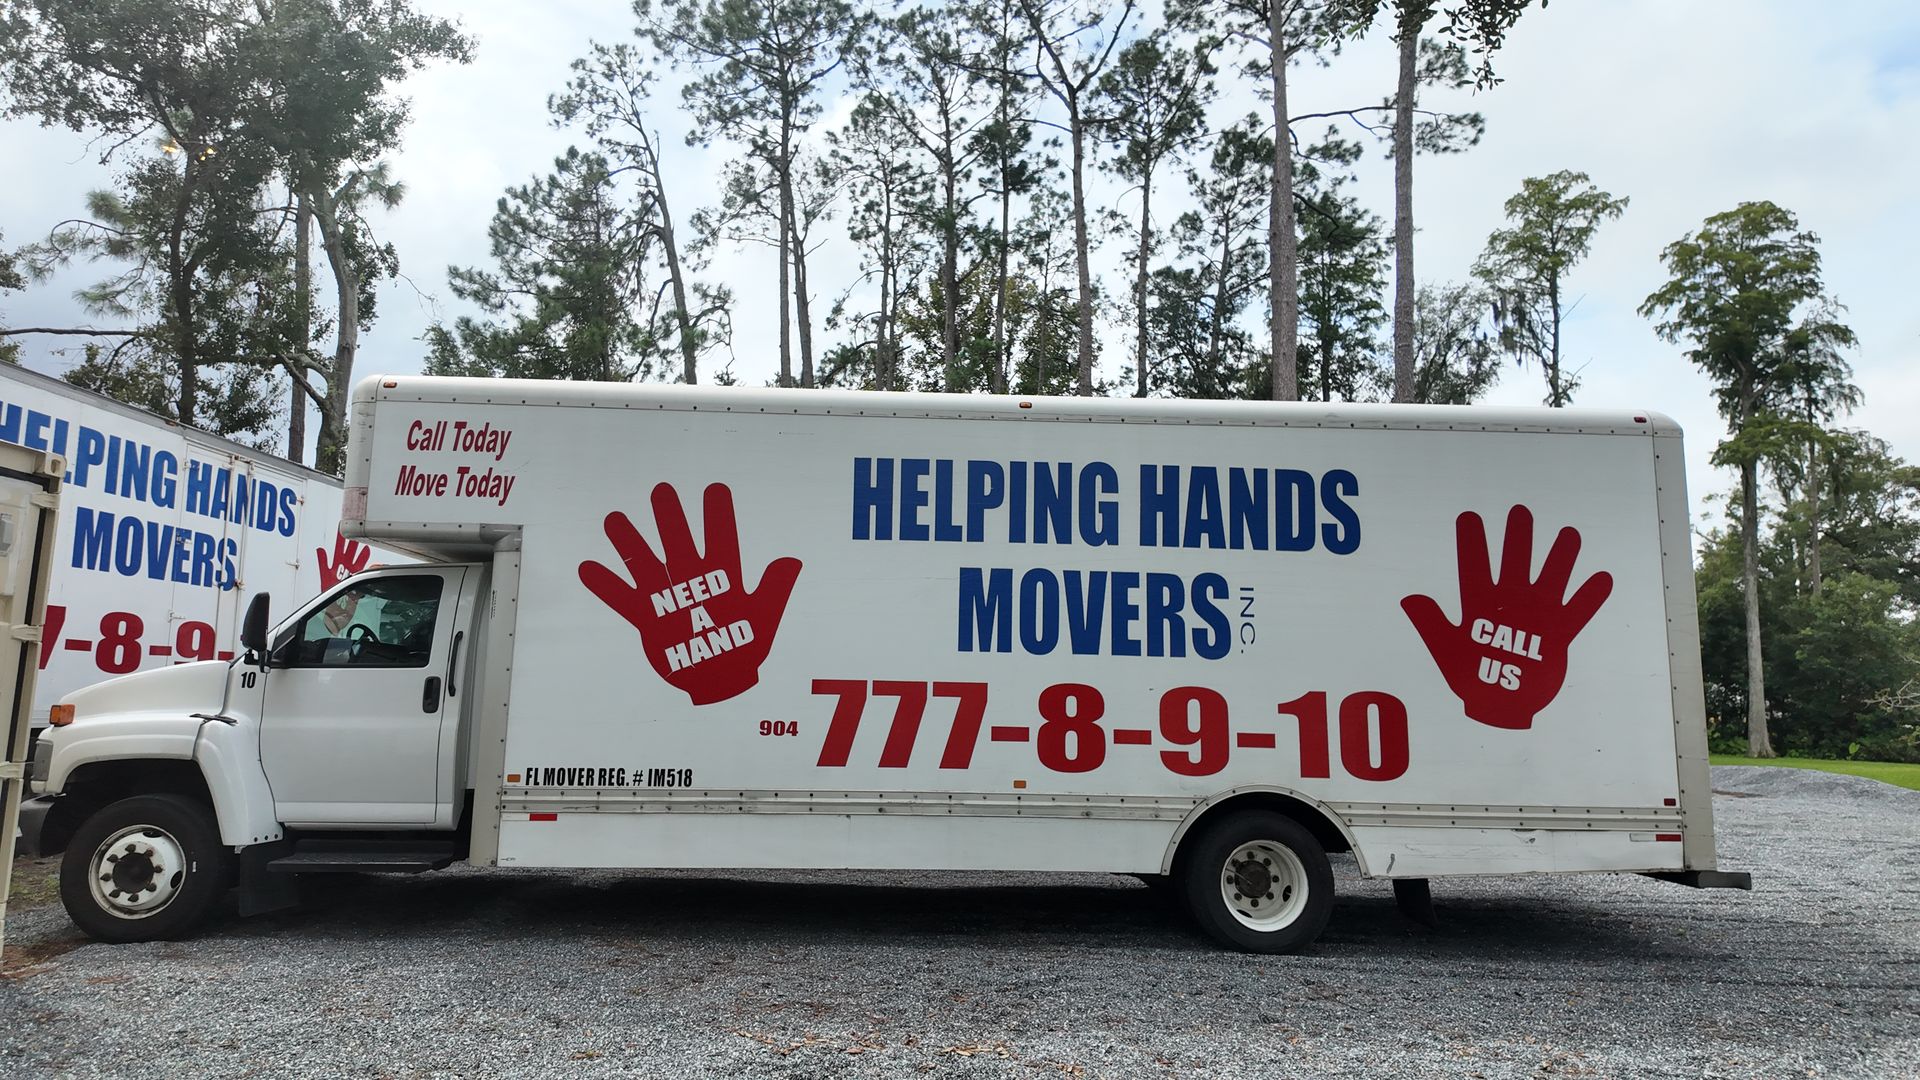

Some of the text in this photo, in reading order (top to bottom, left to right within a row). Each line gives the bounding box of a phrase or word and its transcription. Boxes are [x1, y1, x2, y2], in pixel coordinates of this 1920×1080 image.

[407, 419, 512, 461] Call Today
[185, 458, 297, 538] HANDS
[394, 464, 515, 507] Move Today
[852, 457, 1361, 555] HELPING HANDS
[71, 506, 238, 591] MOVERS
[650, 569, 731, 618] NEED
[957, 567, 1232, 660] MOVERS
[690, 605, 715, 634] A
[1239, 587, 1256, 654] INC.
[1471, 618, 1543, 662] CALL
[664, 619, 755, 673] HAND
[240, 671, 257, 689] 10
[1478, 656, 1522, 691] US
[759, 679, 1410, 782] 904 777-8-9-10
[525, 767, 693, 788] FL MOVER REG. # IM518
